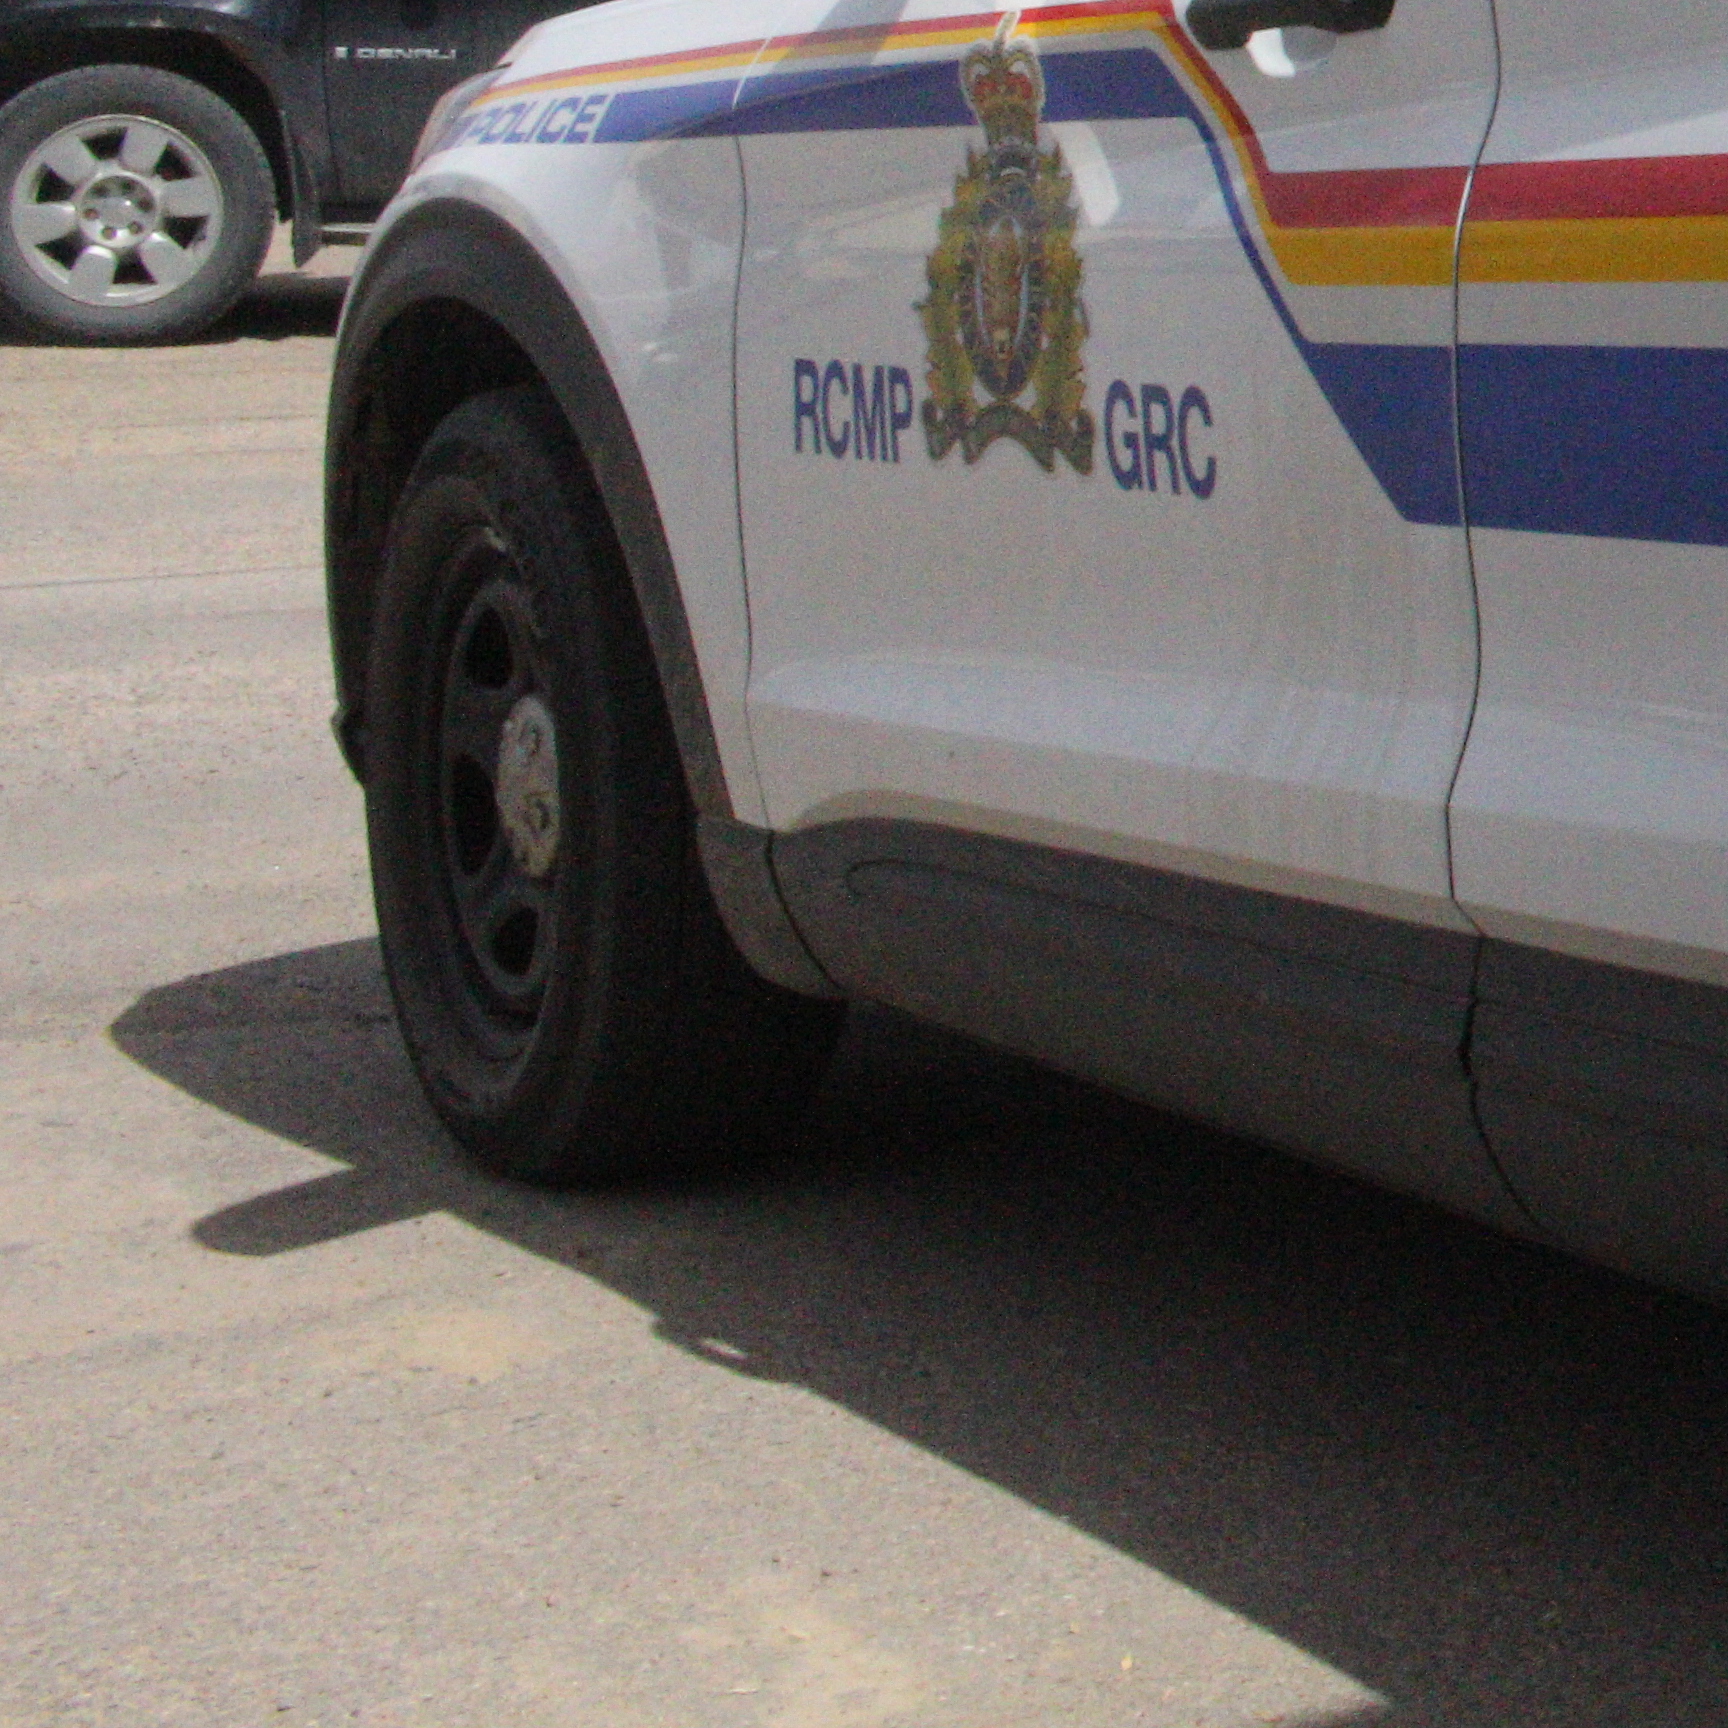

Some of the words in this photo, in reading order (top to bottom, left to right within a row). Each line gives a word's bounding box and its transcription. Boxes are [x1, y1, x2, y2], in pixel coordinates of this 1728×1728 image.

[357, 47, 457, 60] DENALI
[457, 93, 610, 146] POLICE
[794, 358, 914, 463] RCMP
[1104, 379, 1214, 500] GRC
